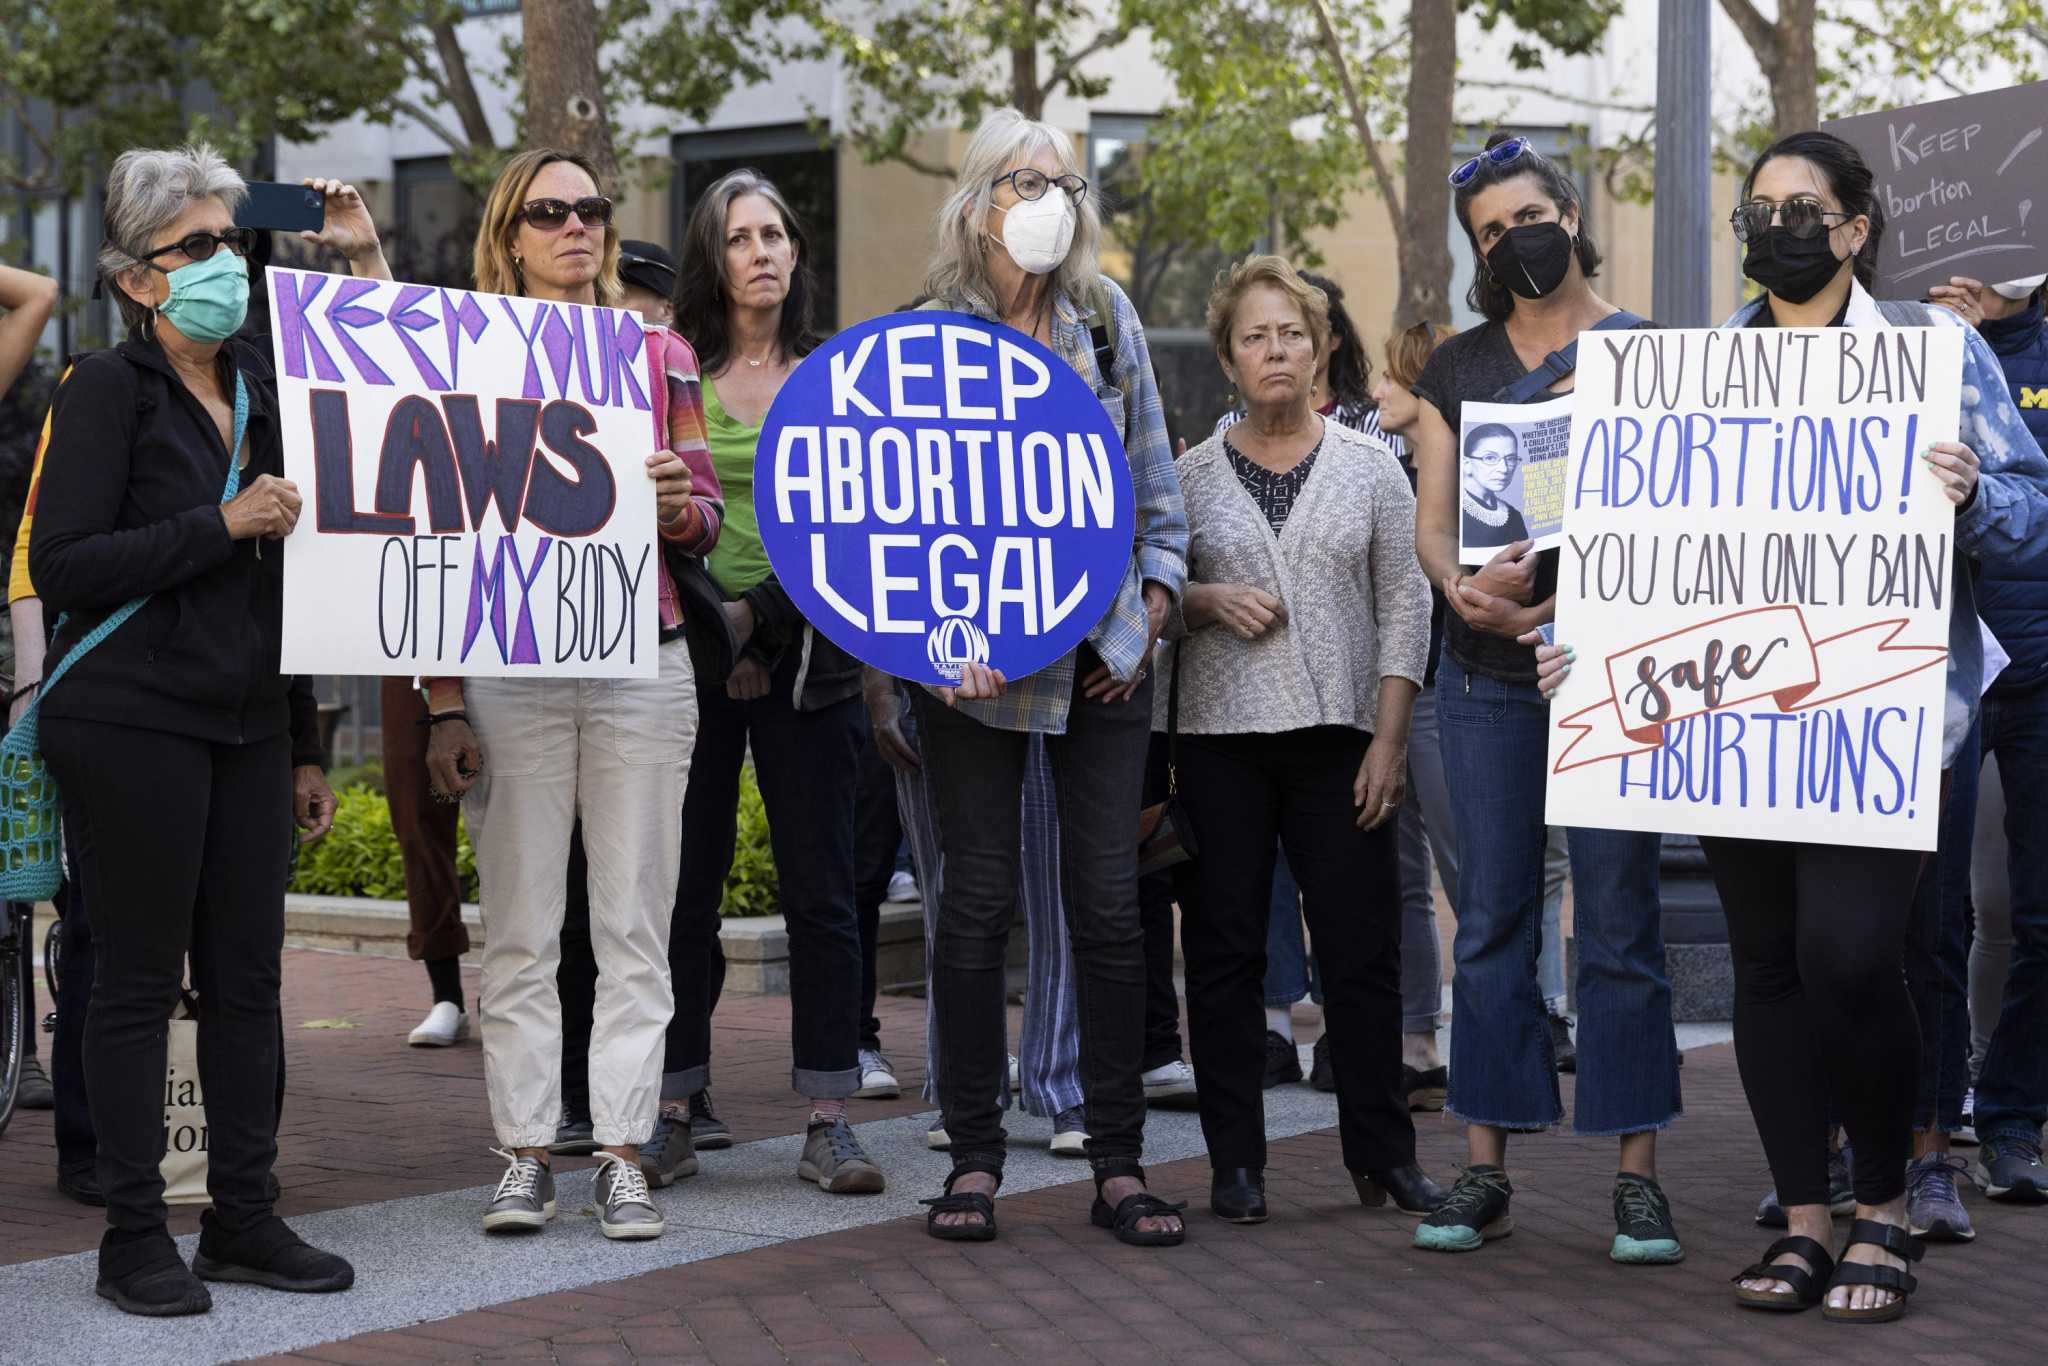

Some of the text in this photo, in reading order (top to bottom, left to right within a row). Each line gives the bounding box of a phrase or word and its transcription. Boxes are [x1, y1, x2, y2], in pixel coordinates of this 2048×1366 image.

[1888, 123, 1981, 172] KEEP
[273, 271, 651, 411] KEEP YOUR
[829, 324, 1051, 421] KEEP
[1604, 330, 1928, 409] YOU CAN'T BAN
[1521, 424, 1568, 439] WHETHER OR NOT
[2020, 387, 2048, 409] M
[309, 388, 616, 538] LAWS
[774, 425, 1115, 529] ABORTION
[1523, 440, 1528, 448] A
[1528, 437, 1545, 447] CHILD
[1546, 436, 1551, 444] IS
[1529, 453, 1547, 463] BEING
[1548, 450, 1560, 460] AND
[378, 532, 650, 666] OFF MY BODY
[810, 533, 1089, 636] LEGAL
[1568, 531, 1947, 610] YOU CAN ONLY BAN
[927, 617, 990, 664] NOW
[1625, 637, 1789, 722] safe
